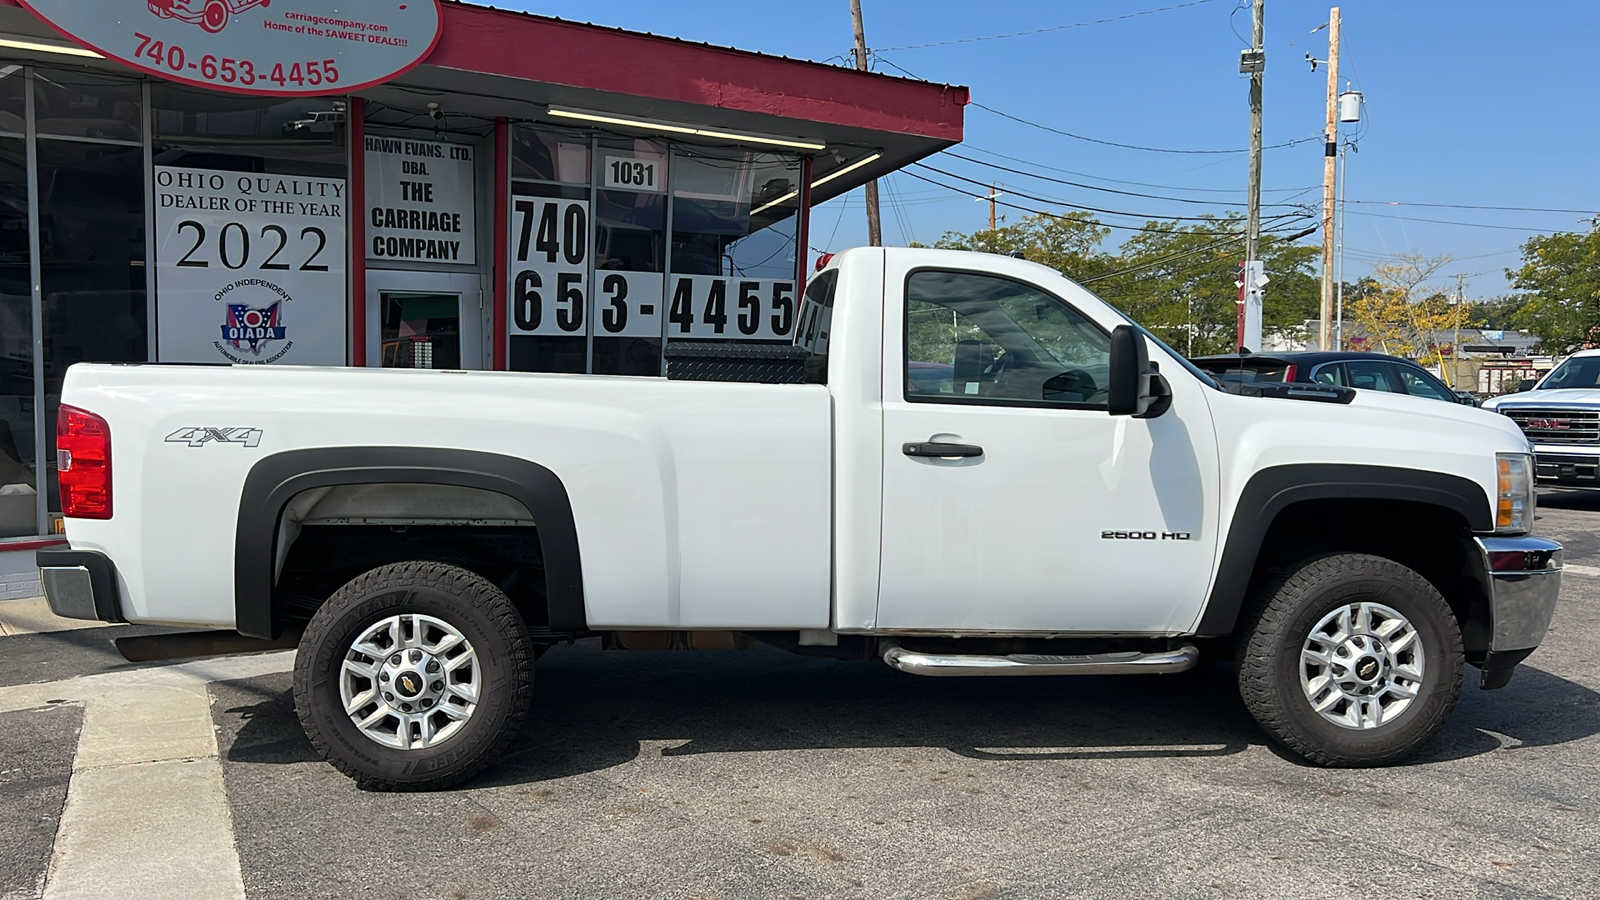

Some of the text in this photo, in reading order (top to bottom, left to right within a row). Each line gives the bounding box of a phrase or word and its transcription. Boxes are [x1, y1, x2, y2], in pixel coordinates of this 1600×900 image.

[285, 12, 388, 31] carriagecompany.com
[264, 20, 408, 47] Home of the SAWEET DEALS!!!
[134, 32, 339, 87] 740-653-4455
[450, 147, 472, 161] LTD.
[402, 161, 430, 176] DBA.
[611, 161, 654, 186] 1031
[157, 171, 344, 198] OHIO QUALITY
[400, 181, 433, 202] THE
[160, 194, 341, 217] DEALER OF THE YEAR
[371, 207, 461, 233] CARRIAGE
[515, 200, 586, 265] 740
[176, 220, 329, 272] 2022
[373, 236, 460, 260] COMPANY
[214, 279, 292, 302] OHIO INDEPENDENT
[229, 327, 275, 339] OIADA
[213, 341, 242, 365] AUTOMOBILE
[266, 341, 294, 365] ASSOCIATION
[1526, 419, 1570, 429] GMC
[1101, 531, 1190, 540] 2500 HD
